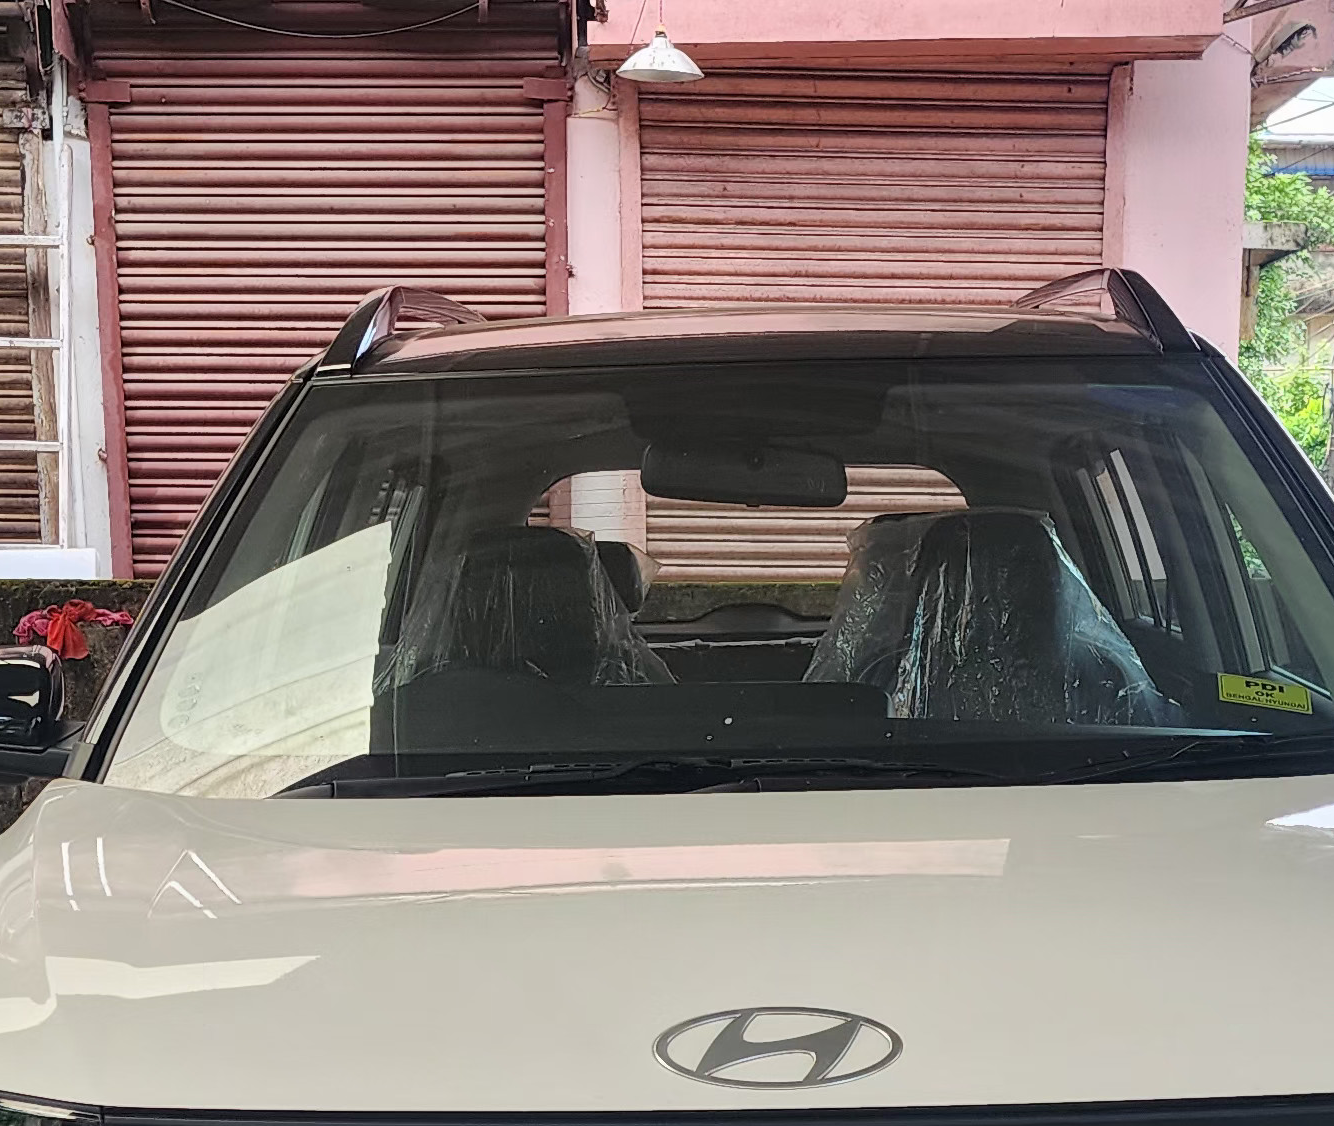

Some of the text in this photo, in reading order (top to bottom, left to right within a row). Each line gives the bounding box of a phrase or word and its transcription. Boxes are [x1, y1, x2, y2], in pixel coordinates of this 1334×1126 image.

[1244, 680, 1285, 693] PDI
[1226, 692, 1307, 709] BENGAL HYUNDAI
[1254, 690, 1275, 698] OK
